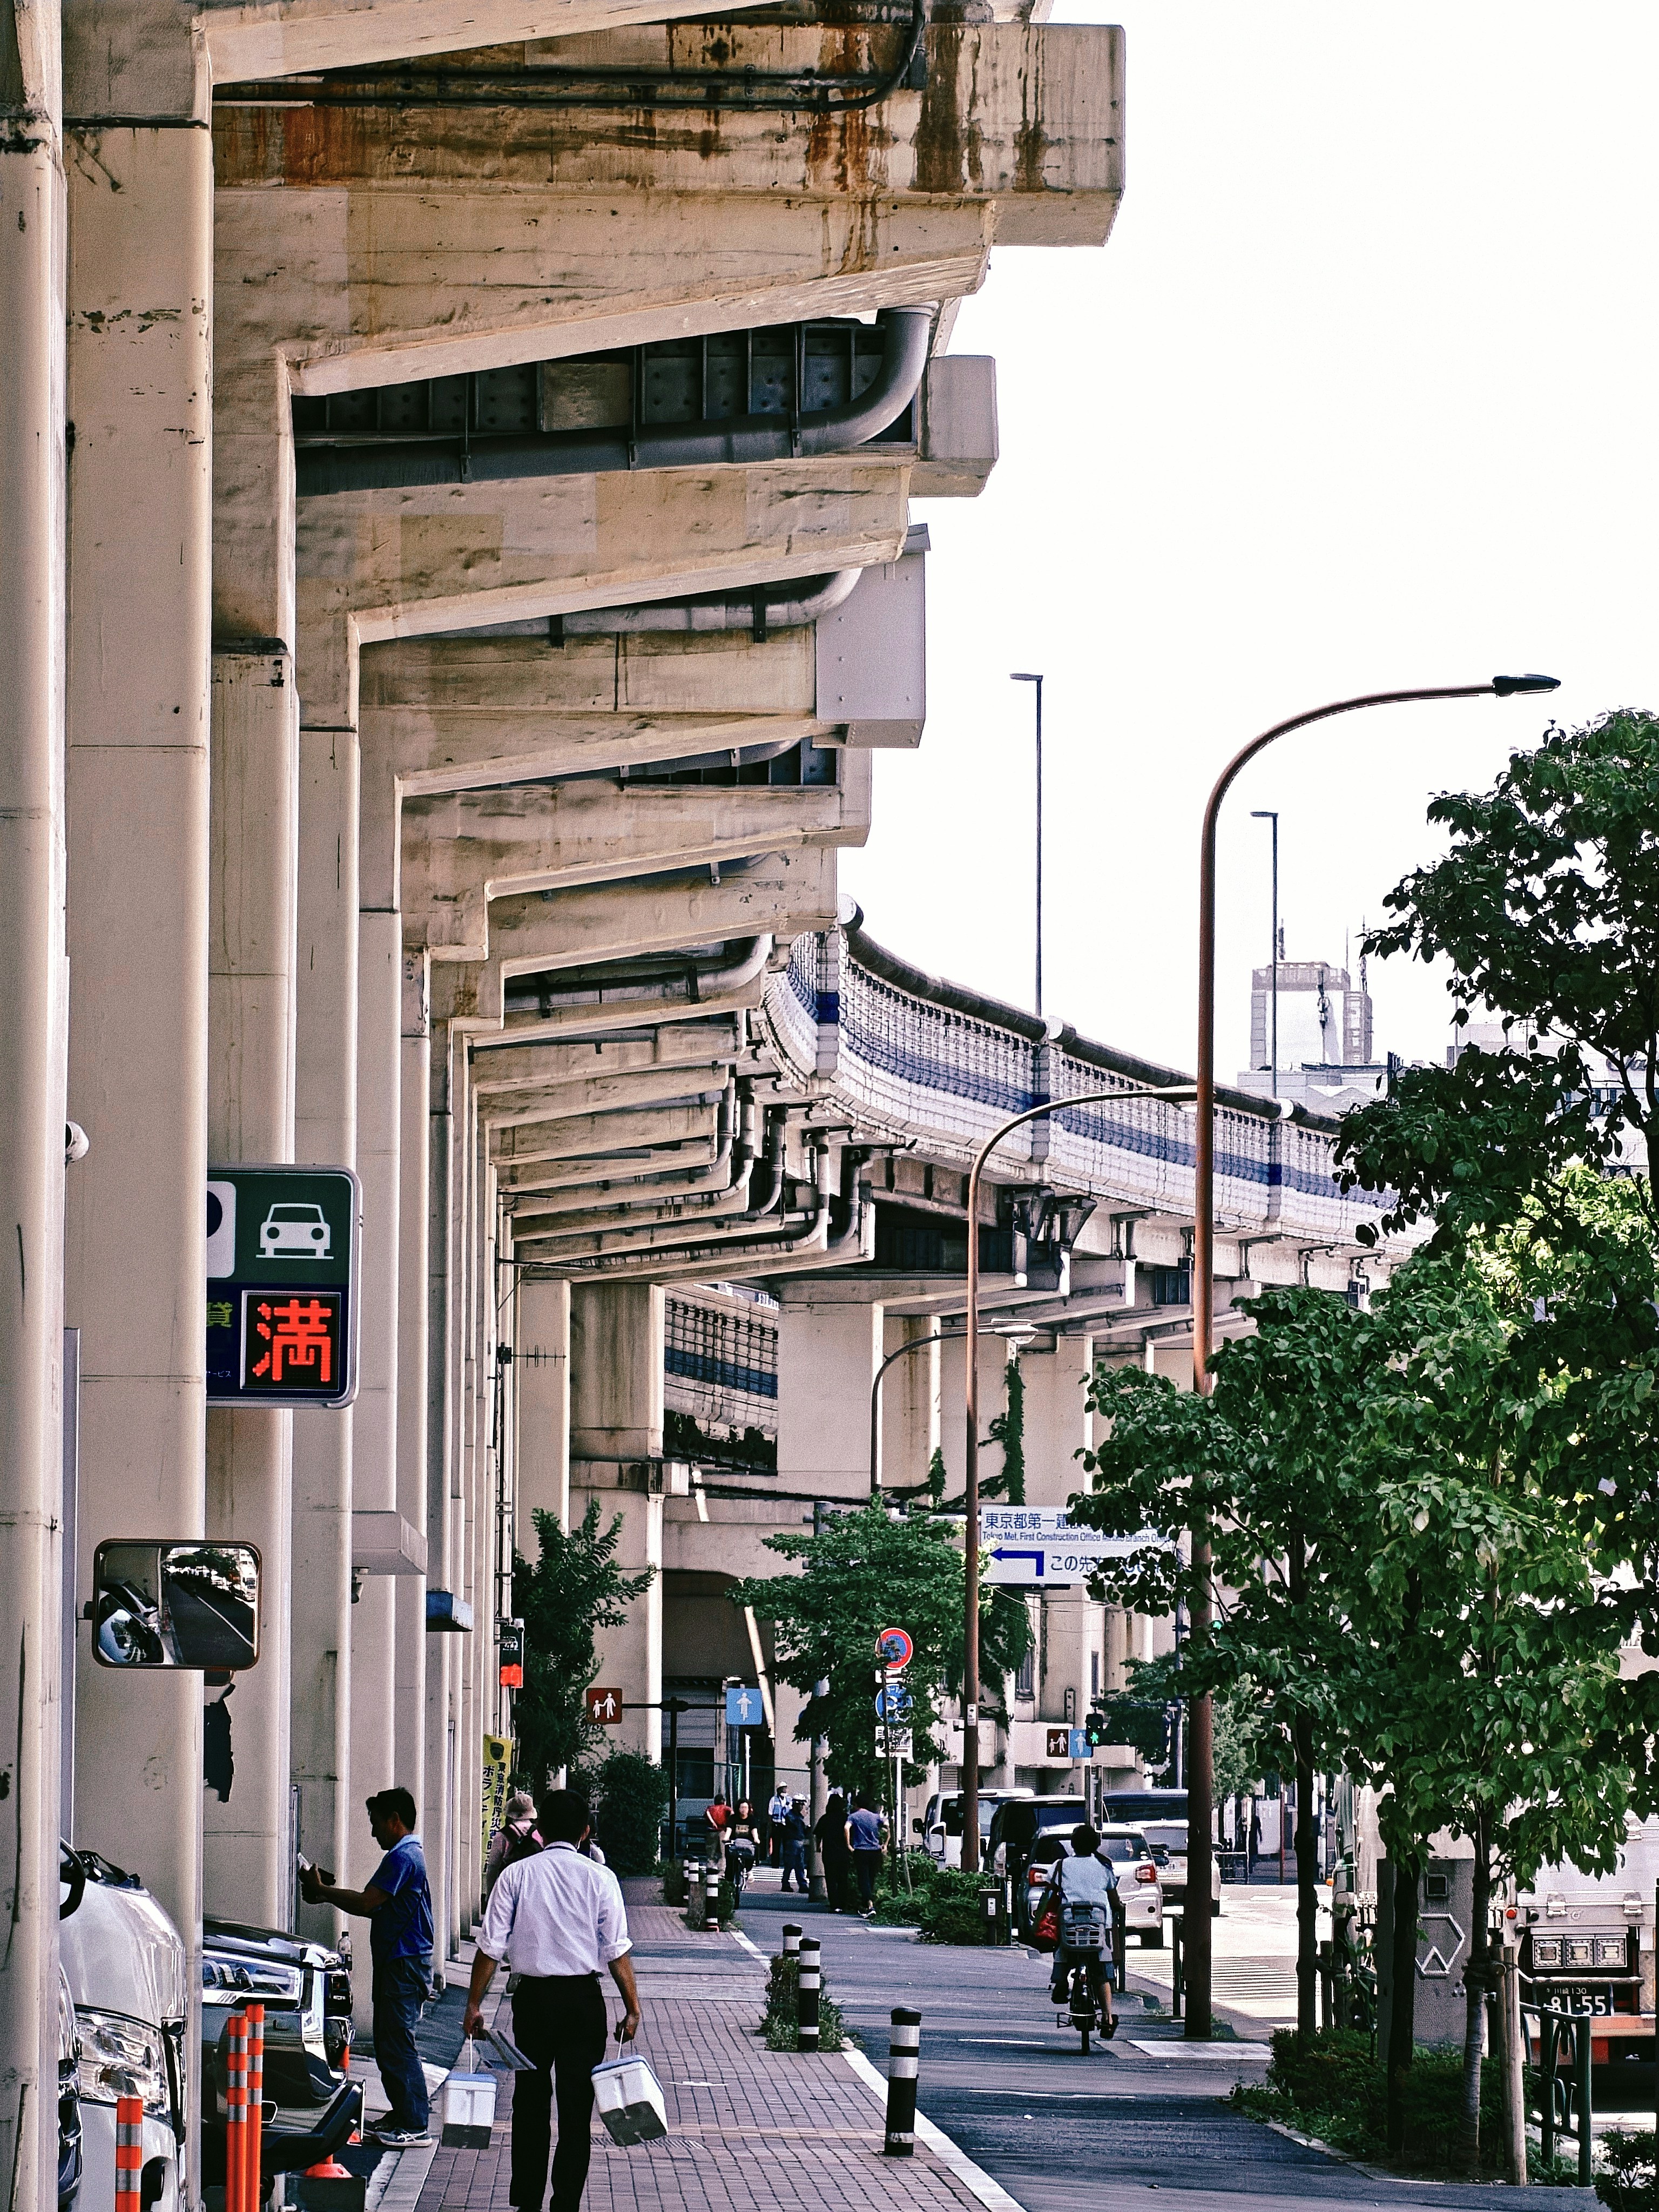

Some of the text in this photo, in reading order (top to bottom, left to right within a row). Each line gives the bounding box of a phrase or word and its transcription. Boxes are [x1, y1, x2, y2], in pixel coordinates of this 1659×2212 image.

[252, 1299, 332, 1382] 満
[1004, 1532, 1017, 1541] Met.
[1020, 1532, 1035, 1541] First
[1036, 1532, 1078, 1541] Construction
[1080, 1532, 1100, 1541] Office
[1551, 1995, 1606, 2015] 81-55
